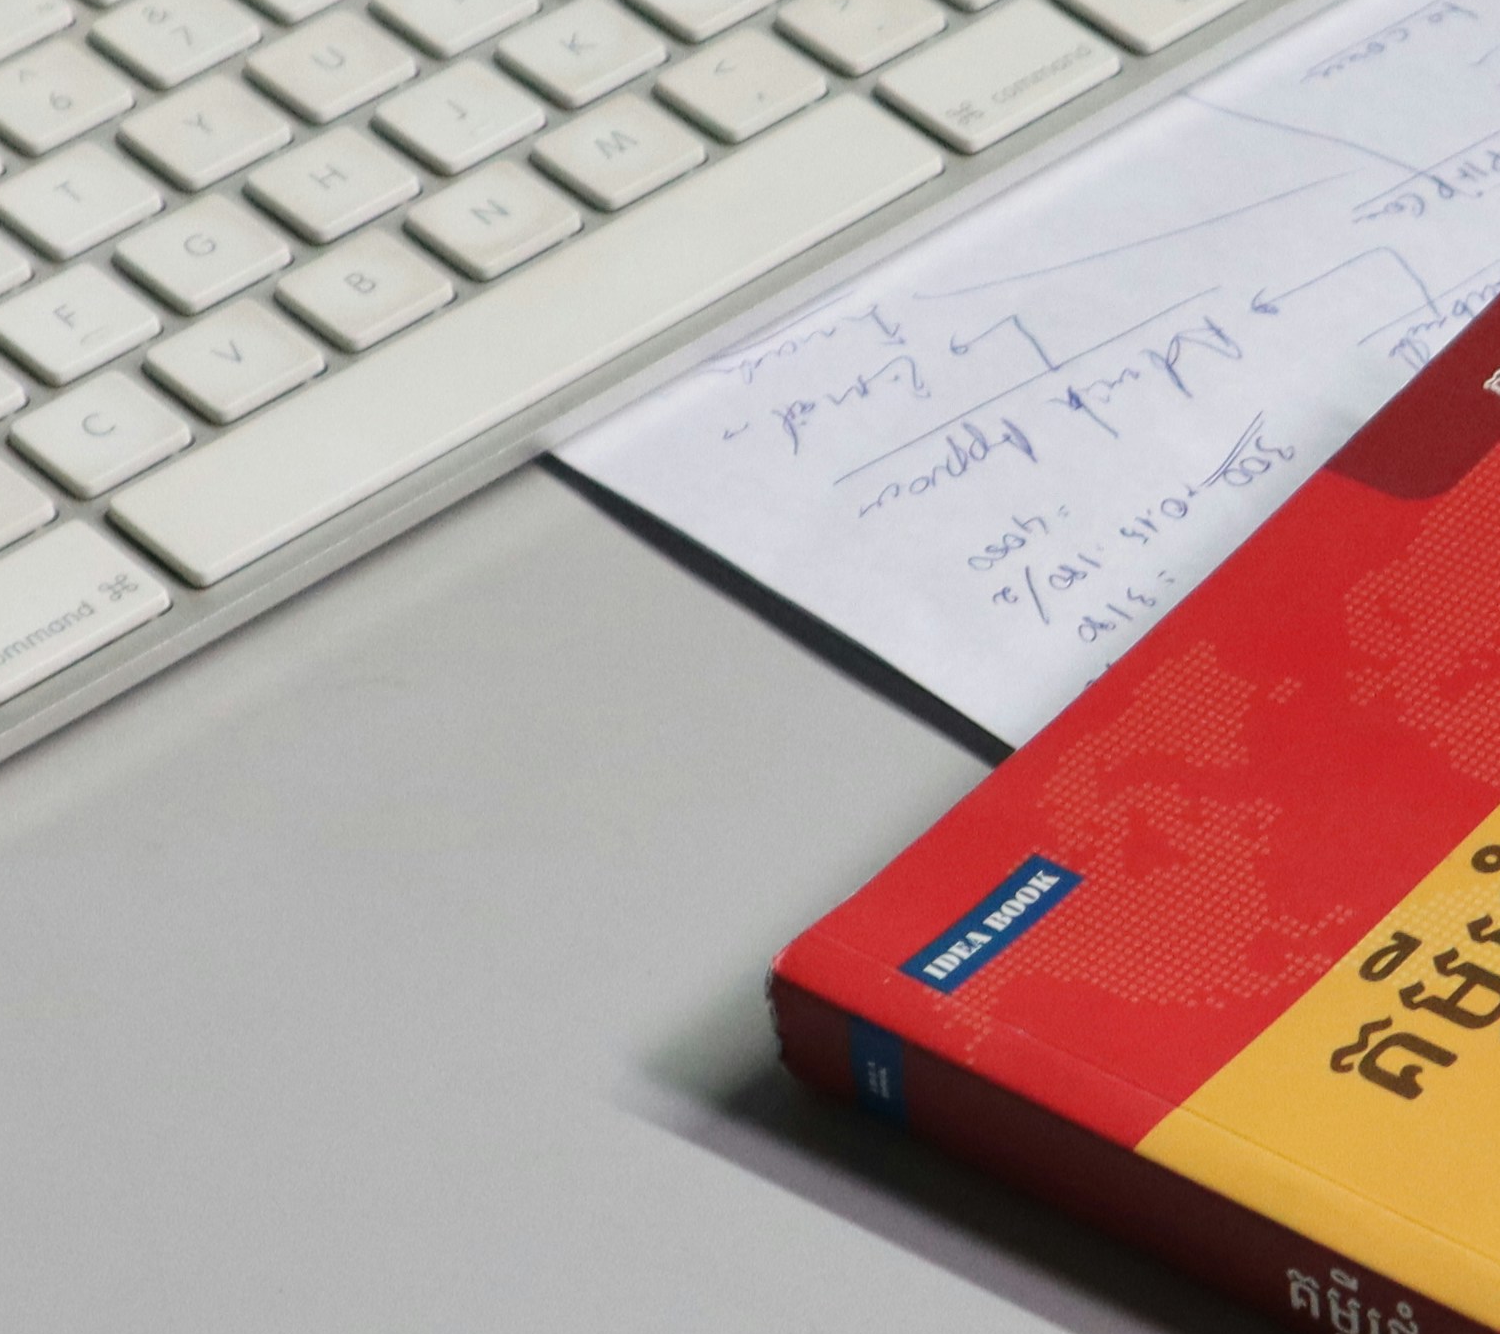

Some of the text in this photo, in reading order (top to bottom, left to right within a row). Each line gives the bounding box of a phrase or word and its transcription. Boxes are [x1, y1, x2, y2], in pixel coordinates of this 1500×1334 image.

[566, 33, 597, 58] K
[311, 48, 346, 71] U
[48, 89, 73, 113] 6
[184, 110, 214, 136] Y
[595, 128, 636, 156] M
[314, 165, 348, 190] H
[54, 180, 82, 205] T
[472, 198, 509, 226] N
[184, 233, 217, 259] G
[350, 270, 376, 295] B
[54, 303, 81, 331] F
[212, 343, 244, 369] V
[82, 414, 116, 440] C
[923, 870, 1060, 980] IDEA BOOK
